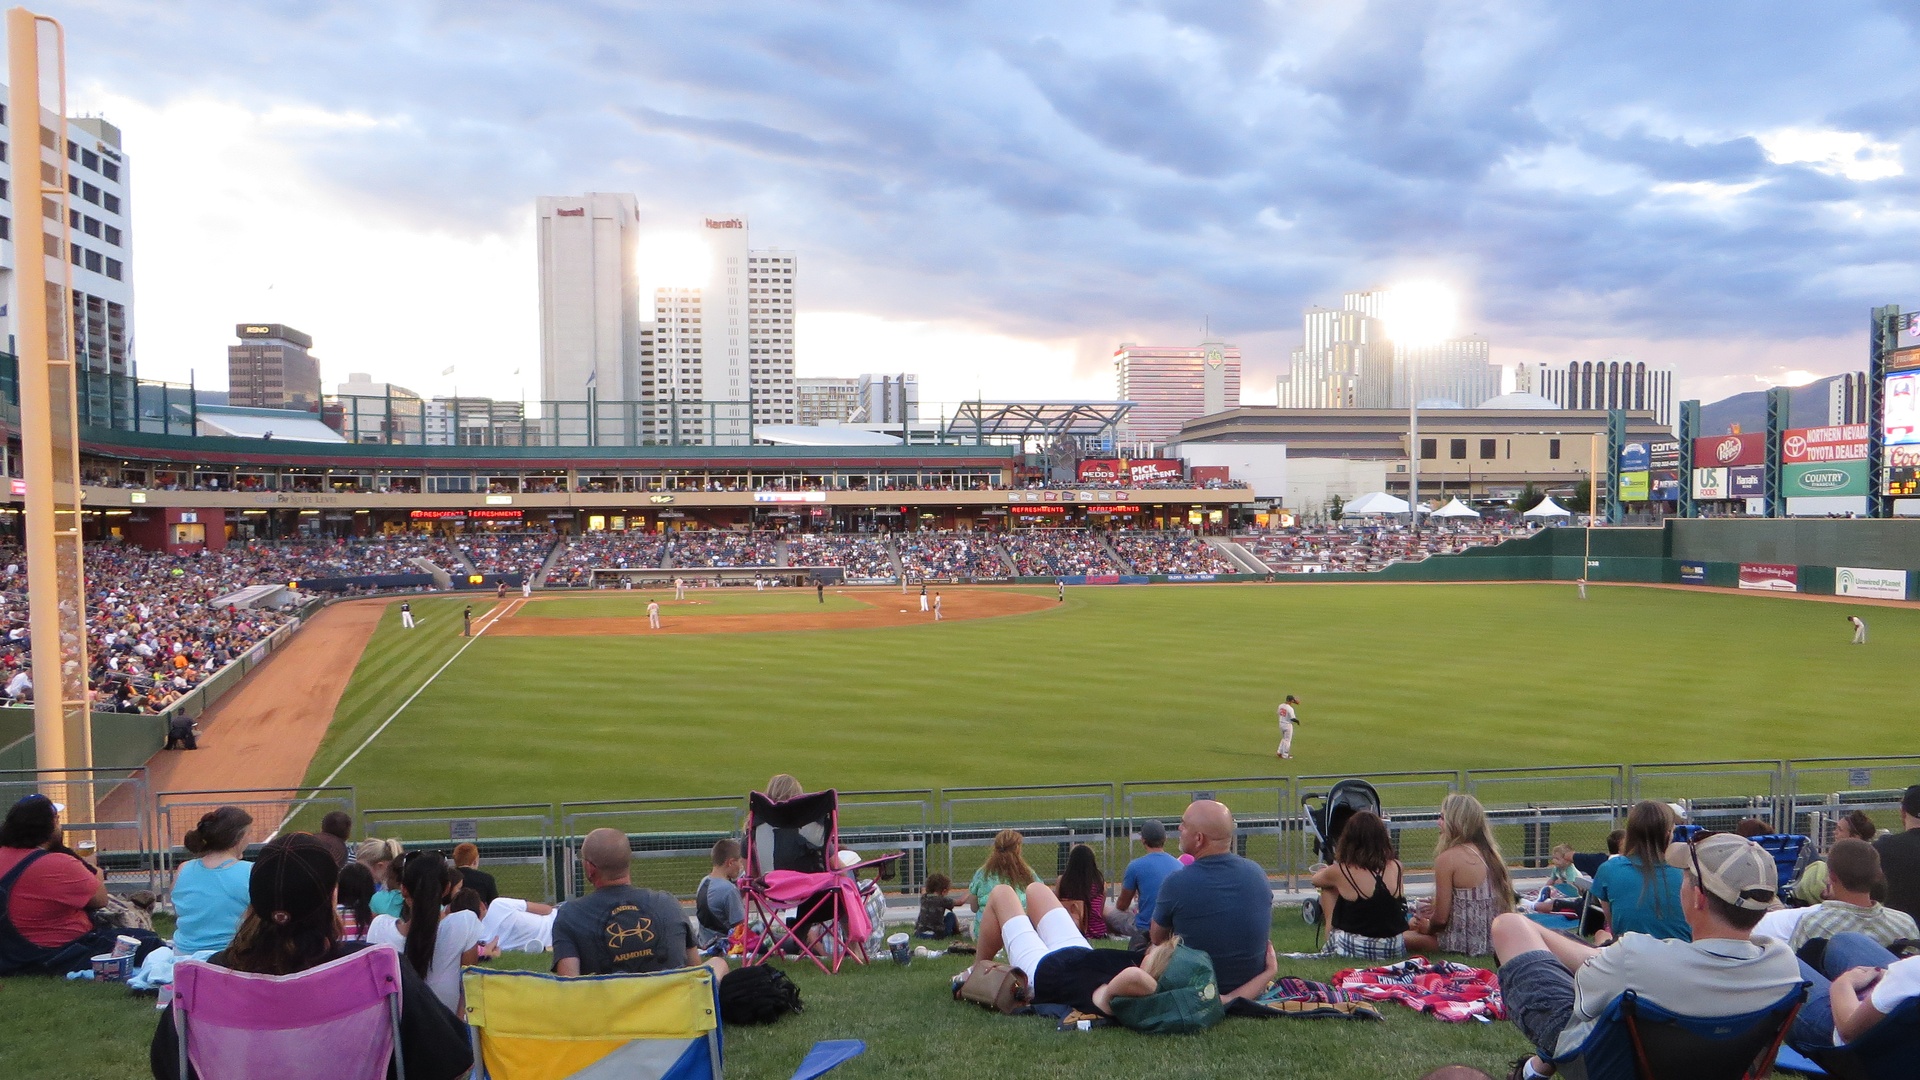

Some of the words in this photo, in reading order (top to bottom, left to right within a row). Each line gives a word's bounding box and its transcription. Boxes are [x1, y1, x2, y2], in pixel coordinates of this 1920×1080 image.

[705, 217, 743, 229] Harrah's
[246, 326, 270, 334] RENO
[1806, 427, 1841, 443] NORTHERN
[1842, 424, 1869, 441] NEVADA
[1719, 443, 1739, 460] Pepper
[1806, 445, 1833, 461] TOYOTA
[1835, 443, 1869, 460] DEALERS
[1131, 465, 1157, 475] PICK
[1804, 473, 1843, 483] COUNTRY
[1653, 480, 1659, 490] 2
[1659, 480, 1679, 488] NEWS
[1855, 578, 1881, 586] Unwired
[1881, 579, 1902, 588] Planet
[611, 905, 640, 915] UNDER
[613, 948, 654, 962] ARMOUR
